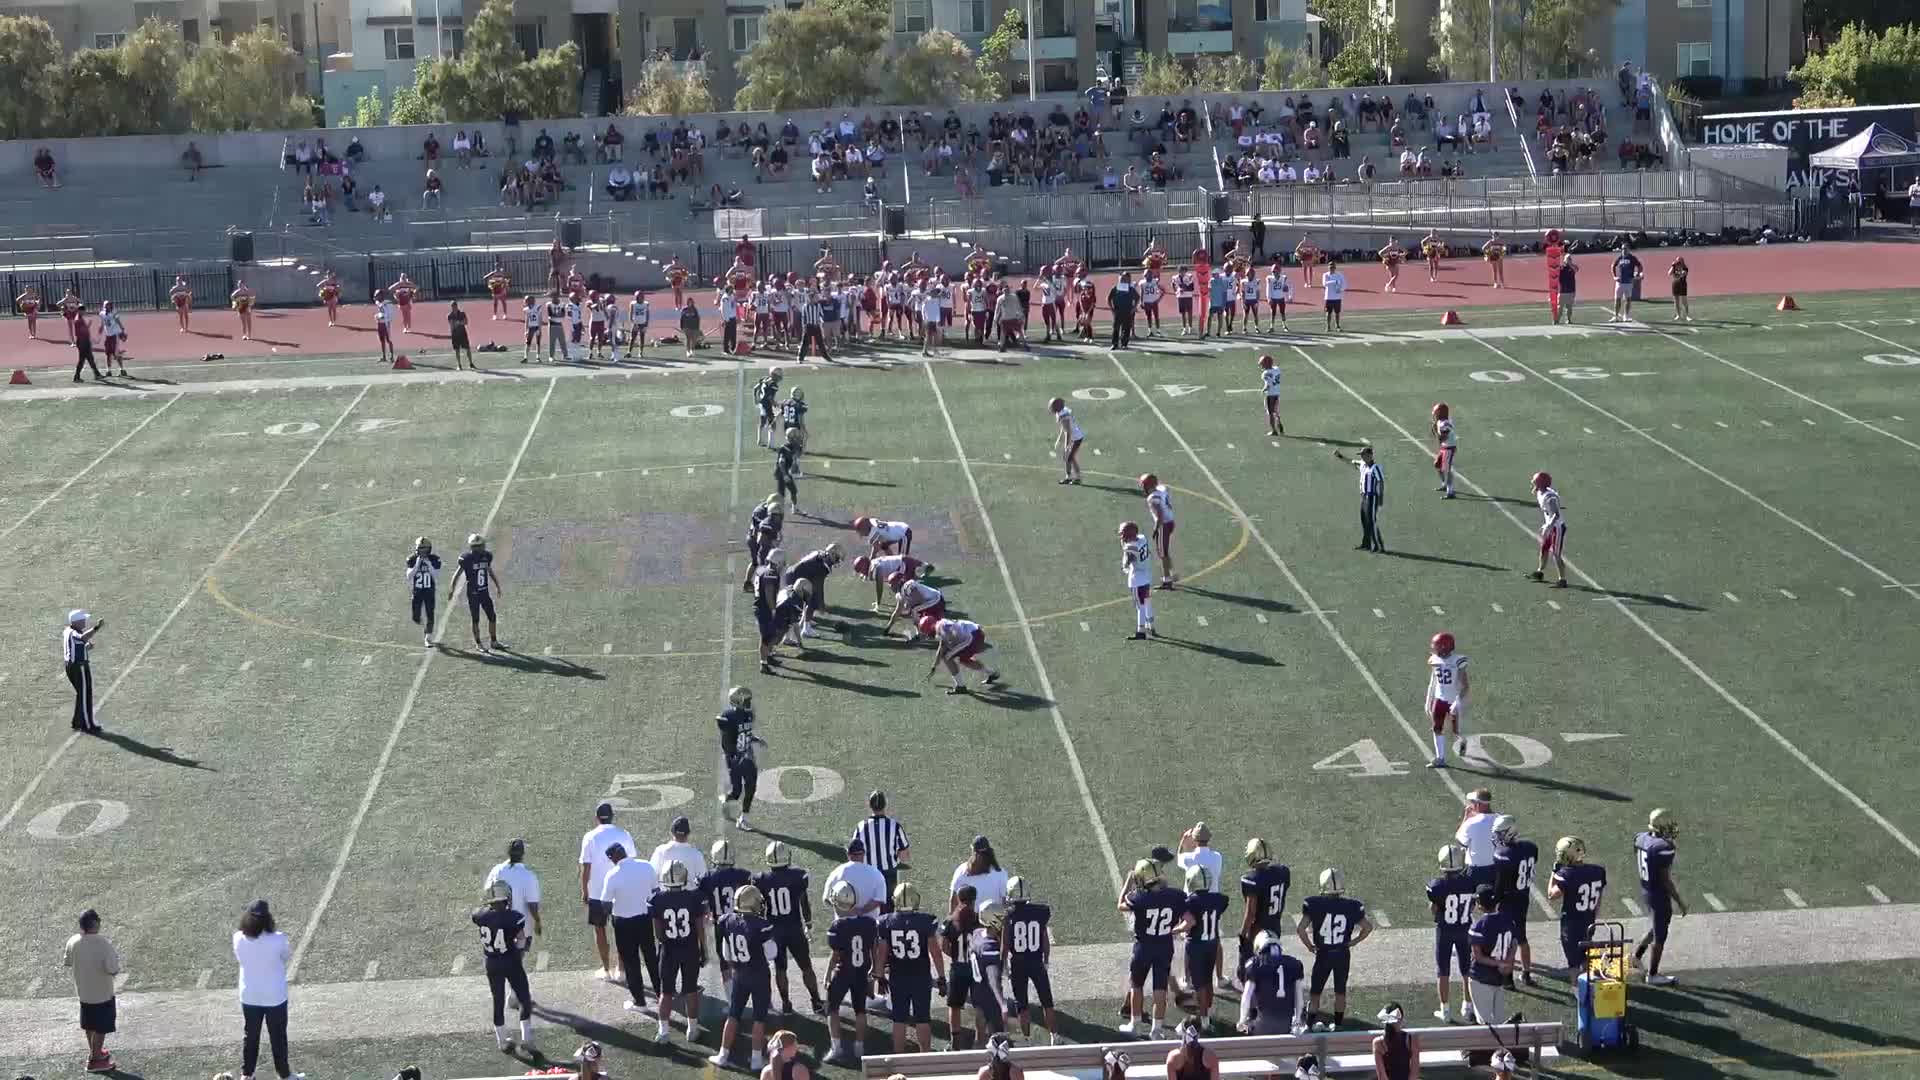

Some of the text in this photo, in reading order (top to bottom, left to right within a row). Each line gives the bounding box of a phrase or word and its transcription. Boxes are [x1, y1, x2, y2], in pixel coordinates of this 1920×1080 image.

[1704, 118, 1849, 144] HOME OF THE
[415, 572, 432, 589] 20
[713, 886, 735, 916] 13
[768, 886, 791, 916] 10
[1268, 883, 1285, 916] 51
[1444, 893, 1473, 925] 87
[1576, 880, 1602, 912] 35
[663, 908, 691, 939] 33
[1013, 920, 1041, 953] 80
[1146, 907, 1174, 936] 72
[1200, 909, 1217, 941] 11
[1319, 912, 1348, 945] 42
[479, 925, 508, 954] 24
[728, 932, 751, 963] 19
[851, 934, 864, 968] 8
[890, 929, 921, 960] 53
[1275, 964, 1286, 998] 1
